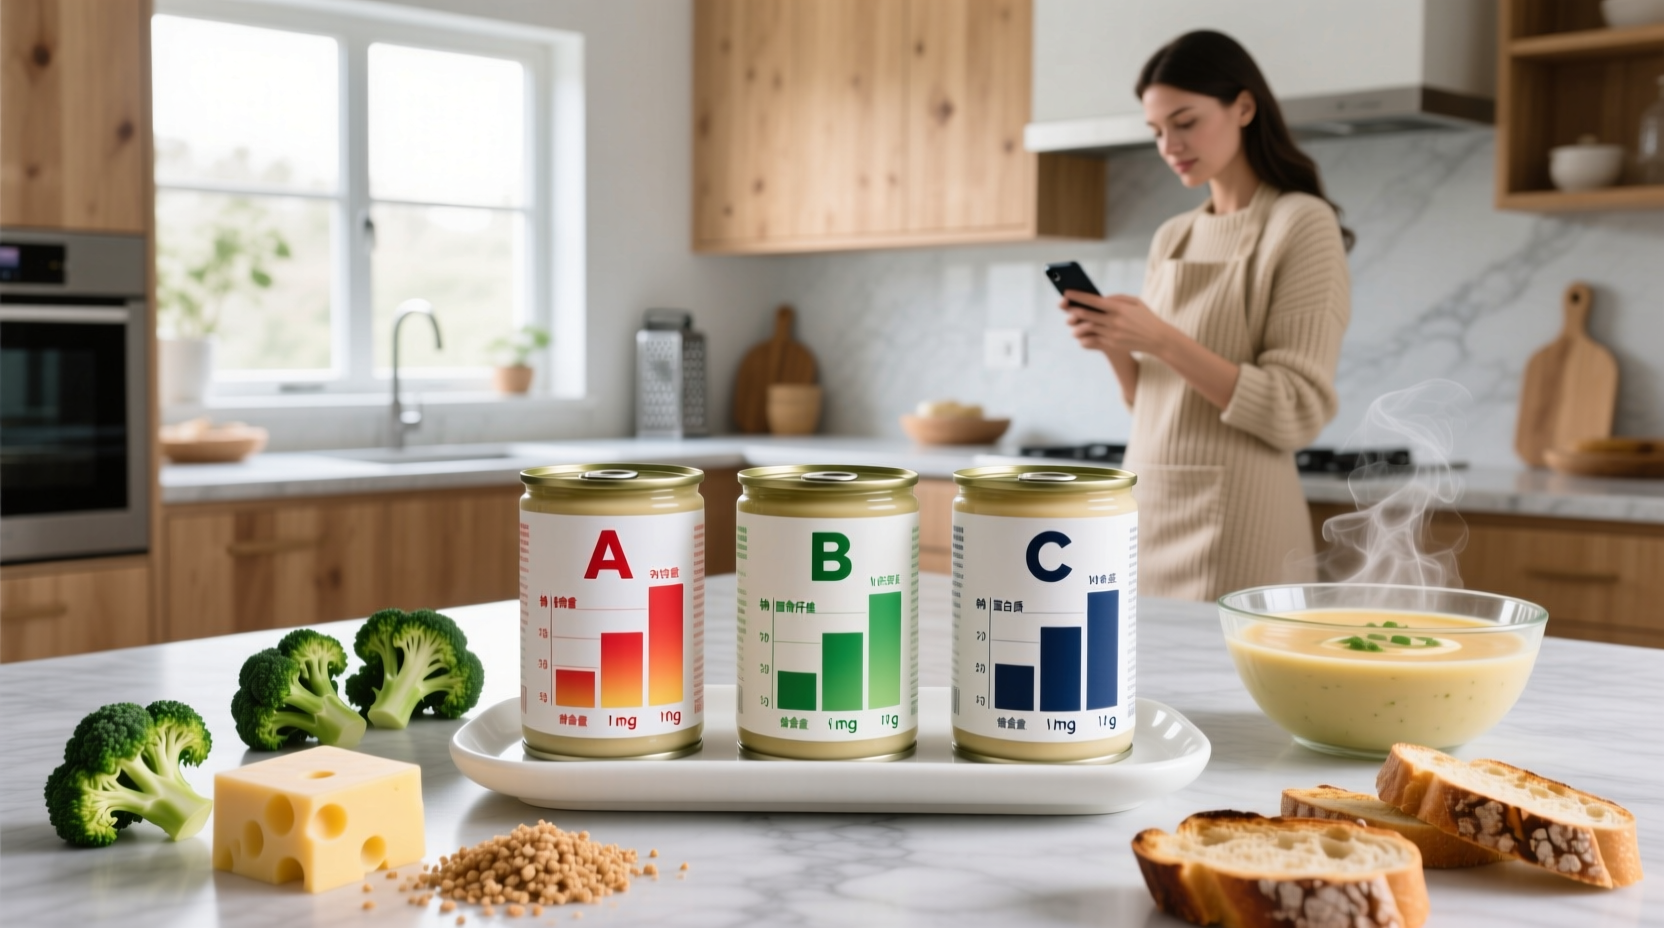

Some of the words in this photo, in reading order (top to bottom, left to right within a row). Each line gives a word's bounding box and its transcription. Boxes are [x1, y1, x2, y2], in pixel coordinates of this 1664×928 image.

[583, 529, 634, 579] A
[811, 531, 852, 582] B
[1025, 530, 1073, 583] C
